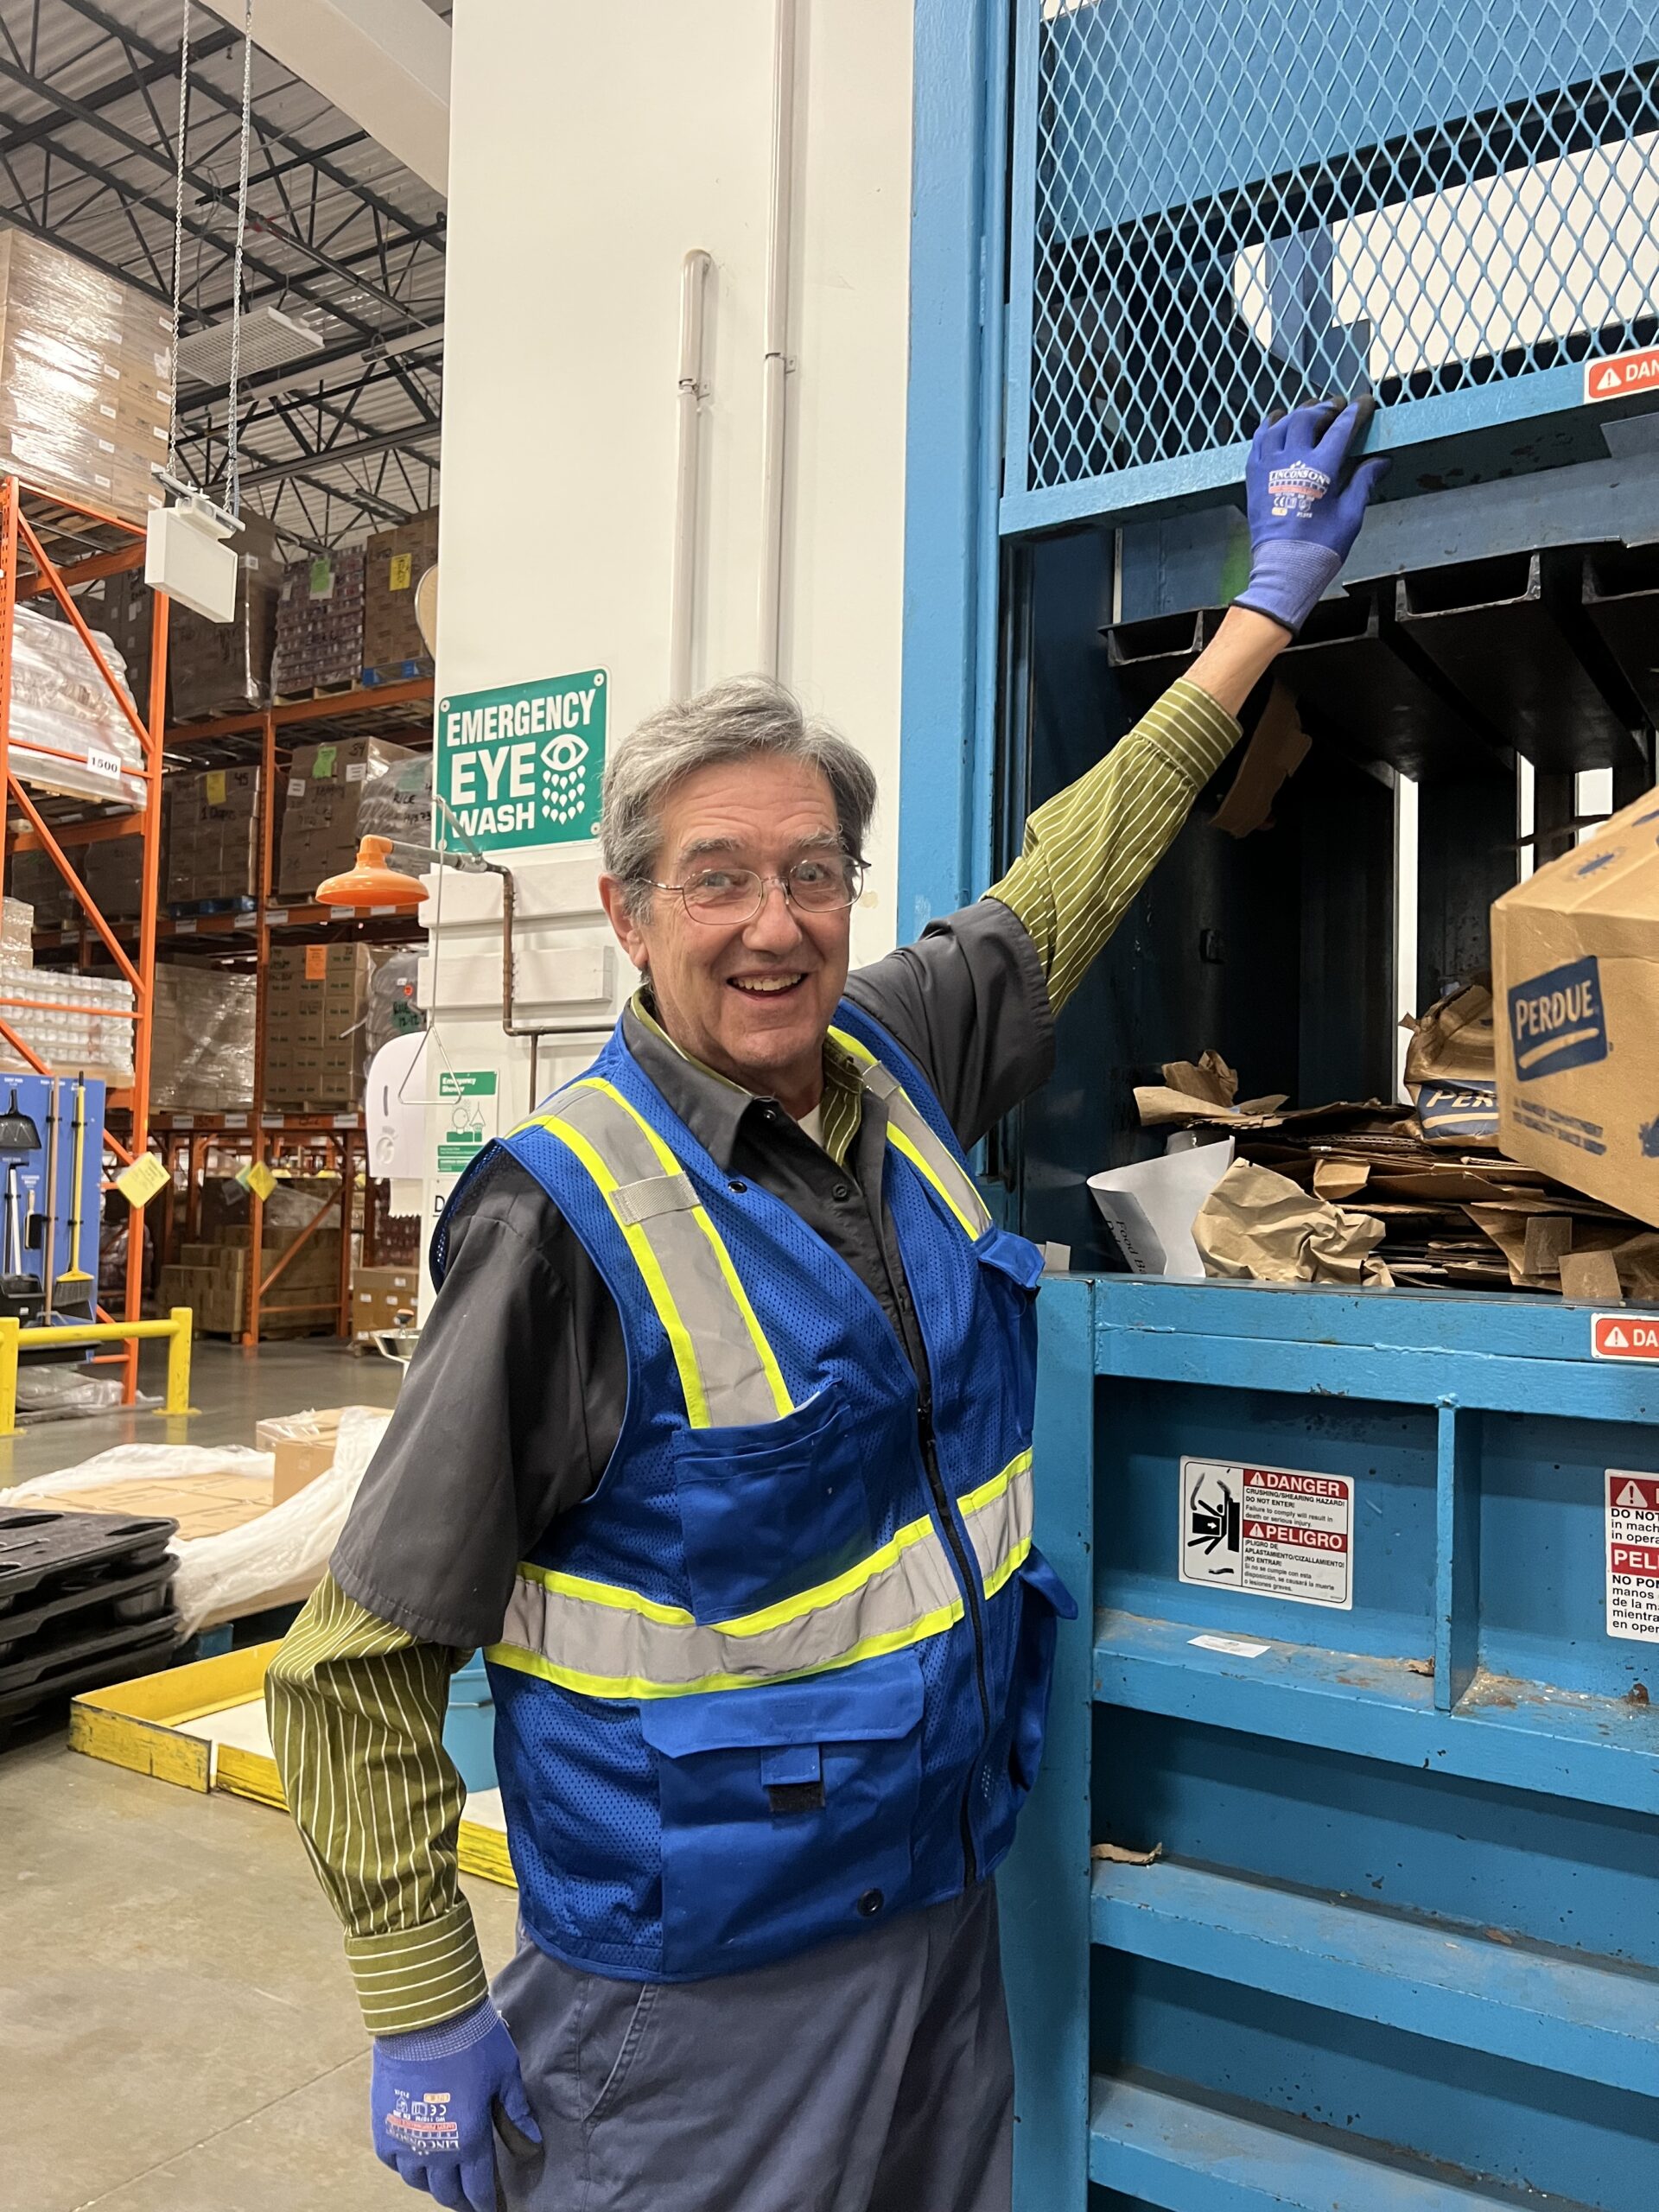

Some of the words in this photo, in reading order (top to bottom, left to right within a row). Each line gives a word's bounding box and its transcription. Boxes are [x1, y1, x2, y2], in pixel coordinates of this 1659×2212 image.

[447, 689, 595, 747] EMERGENCY
[92, 757, 118, 772] 1500
[451, 741, 536, 806] EYE
[452, 801, 535, 839] WASH
[1516, 980, 1594, 1040] PERDUE
[1116, 1220, 1139, 1255] Food
[1267, 1473, 1339, 1497] DANGER
[1246, 1488, 1314, 1502] CRUSHING/SHEARING
[1245, 1504, 1265, 1513] Failure
[1274, 1510, 1295, 1518] comply
[1611, 1509, 1630, 1518] DO
[1611, 1519, 1623, 1529] in
[1266, 1525, 1343, 1549] PELIGRO
[1611, 1530, 1623, 1541] in
[1612, 1575, 1631, 1586] NO
[1613, 1588, 1655, 1599] manos
[1612, 1597, 1628, 1607] de
[1632, 1599, 1643, 1609] la
[1646, 1602, 1659, 1611] m
[1612, 1621, 1628, 1630] en
[389, 2128, 459, 2150] LINCO
